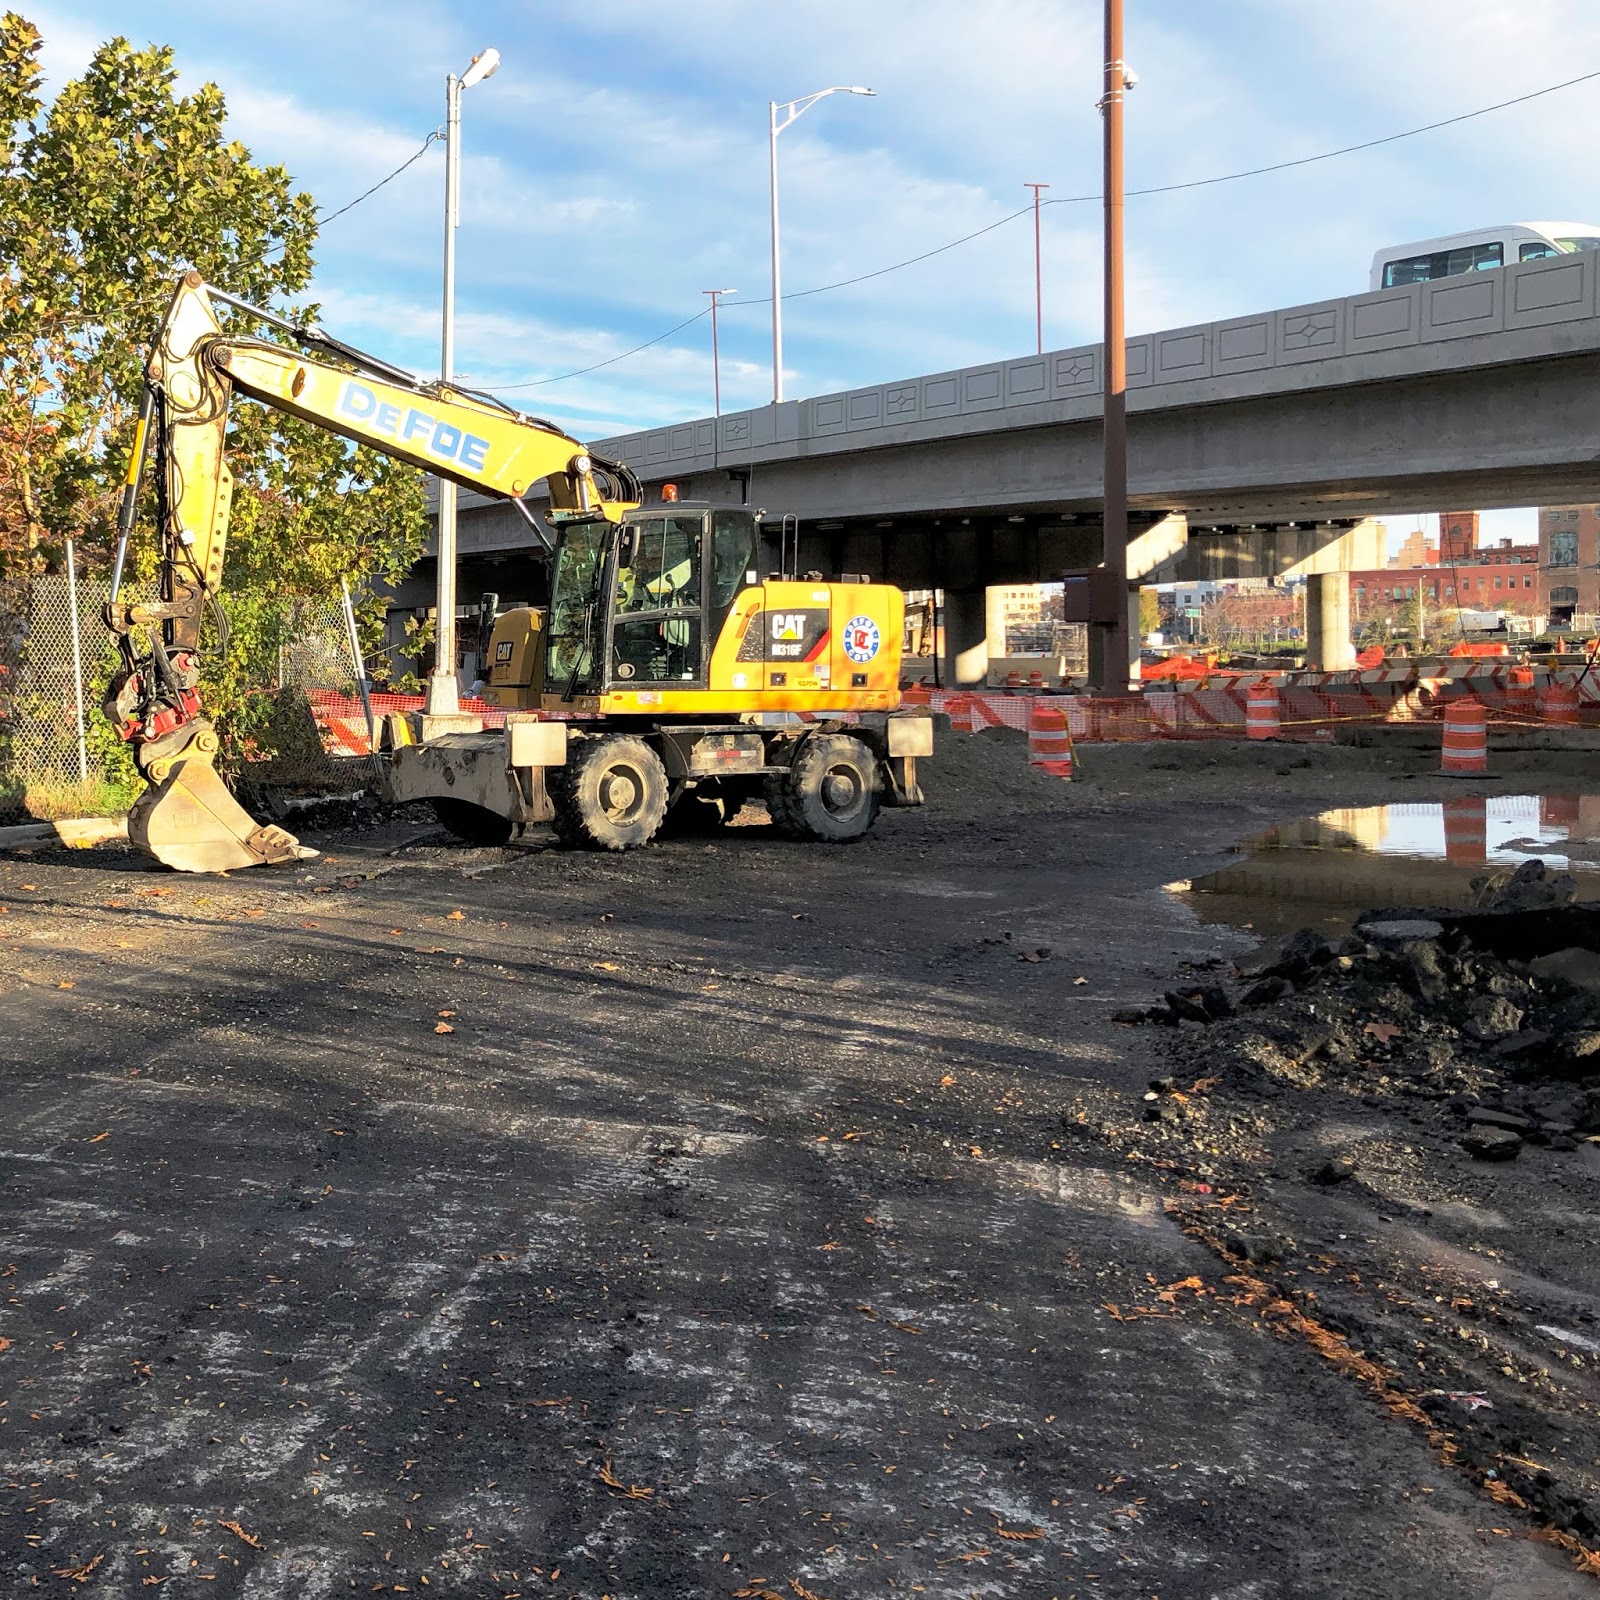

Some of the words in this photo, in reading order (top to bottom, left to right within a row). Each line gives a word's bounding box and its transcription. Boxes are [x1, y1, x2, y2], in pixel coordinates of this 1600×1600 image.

[772, 614, 807, 640] CAT
[497, 643, 512, 660] CAT
[771, 644, 802, 656] M316F
